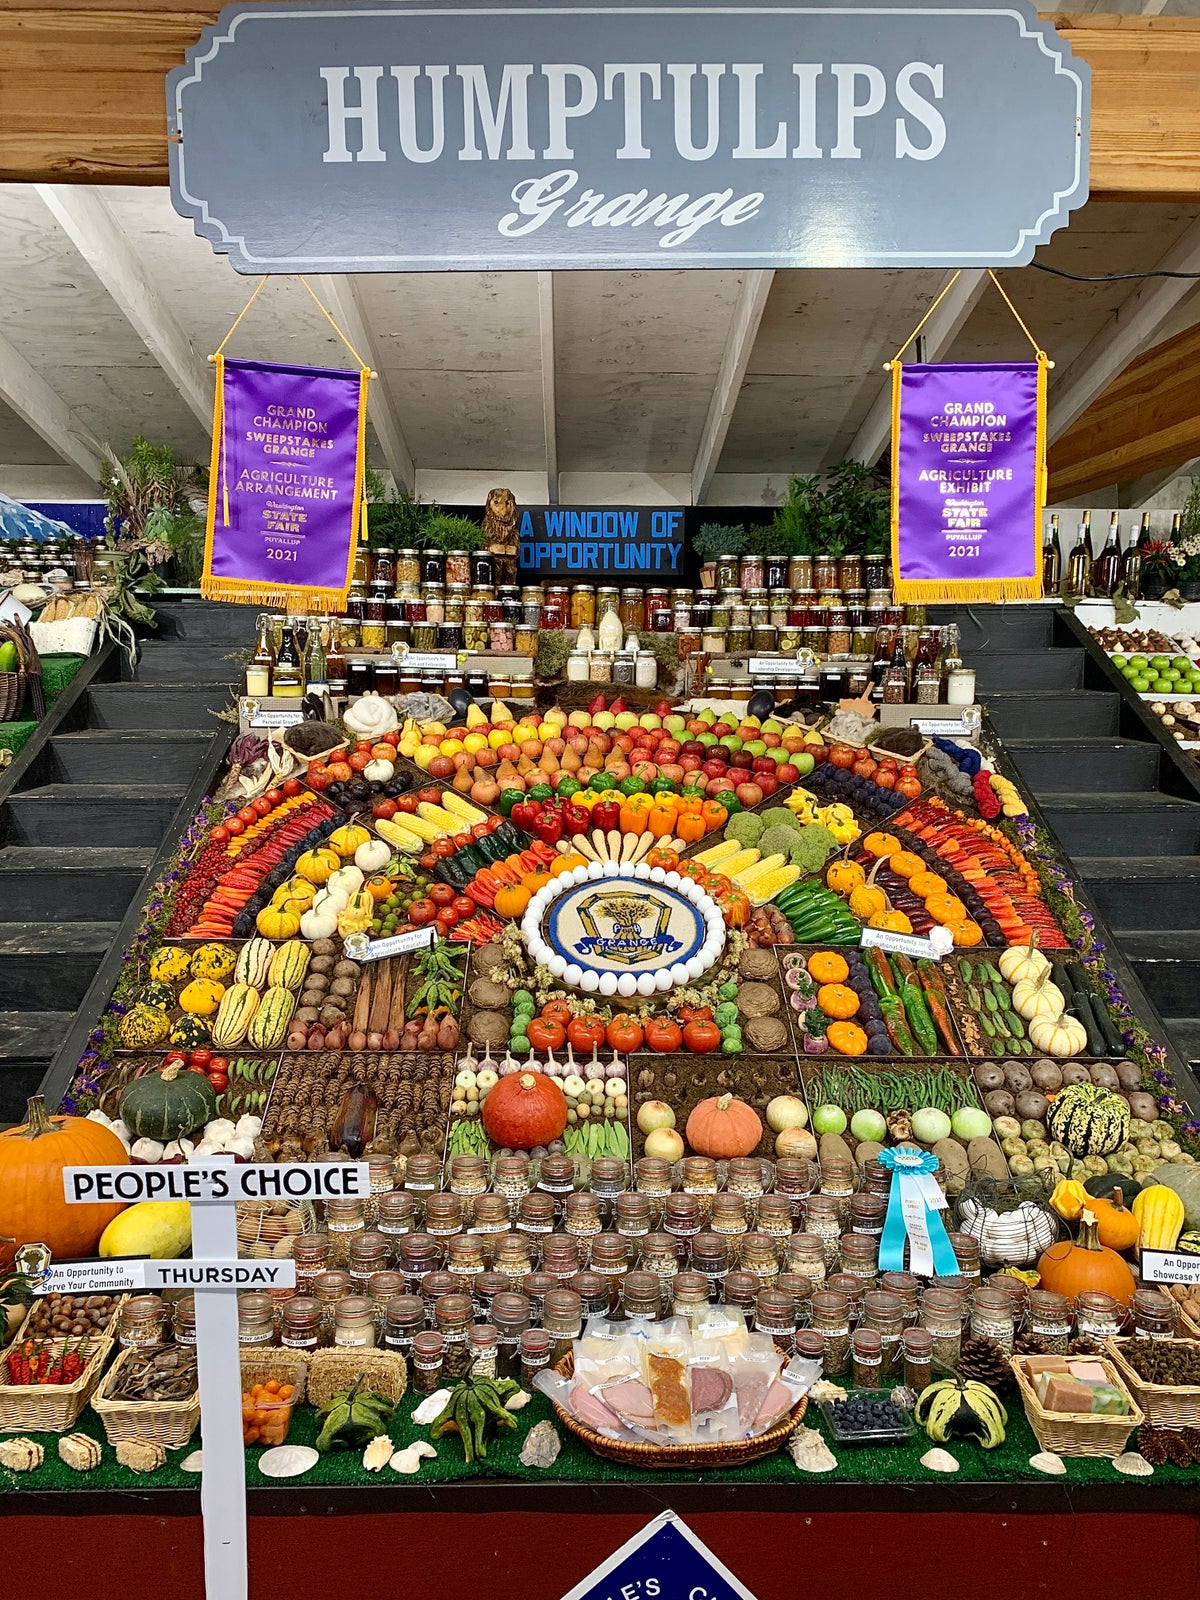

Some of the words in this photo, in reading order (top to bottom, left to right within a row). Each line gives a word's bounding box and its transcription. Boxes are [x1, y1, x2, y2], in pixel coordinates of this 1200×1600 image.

[320, 61, 947, 164] HUMPTULIPS
[497, 169, 765, 248] Grange
[266, 404, 316, 420] GRAND
[944, 402, 995, 415] GRAND
[253, 415, 328, 433] CHAMPION
[930, 414, 1007, 427] CHAMPION
[246, 431, 334, 449] SWEEPSTAKES
[922, 431, 1012, 443] SWEEPSTAKES
[263, 443, 316, 458] GRANGE
[940, 442, 993, 453] GRANGE
[239, 468, 334, 489] AGRICULTURE
[919, 469, 1013, 482] AGRICULTURE
[235, 480, 339, 501] ARRANGEMENT
[939, 481, 992, 494] EXHIBIT
[266, 500, 305, 511] Washington
[945, 498, 985, 508] Washington
[262, 510, 308, 523] STATE
[941, 507, 988, 518] STATE
[267, 520, 300, 533] FAIR
[519, 511, 535, 538] A
[544, 511, 639, 538] WINDOW
[651, 511, 683, 538] OF
[947, 517, 981, 528] FAIR
[264, 536, 300, 545] PUYALLUP
[945, 533, 983, 541] PUYALLUP
[266, 548, 298, 562] 2021
[519, 542, 683, 569] OPPORTUNITY
[948, 545, 980, 557] 2021
[381, 936, 414, 948] Opportunity
[596, 937, 658, 947] GRANGE
[884, 934, 917, 945] Opportunity
[73, 1168, 229, 1200] PEOPLE'S
[240, 1167, 360, 1197] CHOICE
[1163, 1258, 1174, 1267] An
[53, 1270, 65, 1279] An
[66, 1266, 116, 1278] Opportunity
[116, 1266, 124, 1274] to
[158, 1267, 280, 1285] THURSDAY
[1153, 1269, 1193, 1281] Showcase
[42, 1282, 66, 1292] Serve
[67, 1280, 87, 1291] Your
[88, 1278, 135, 1289] Community
